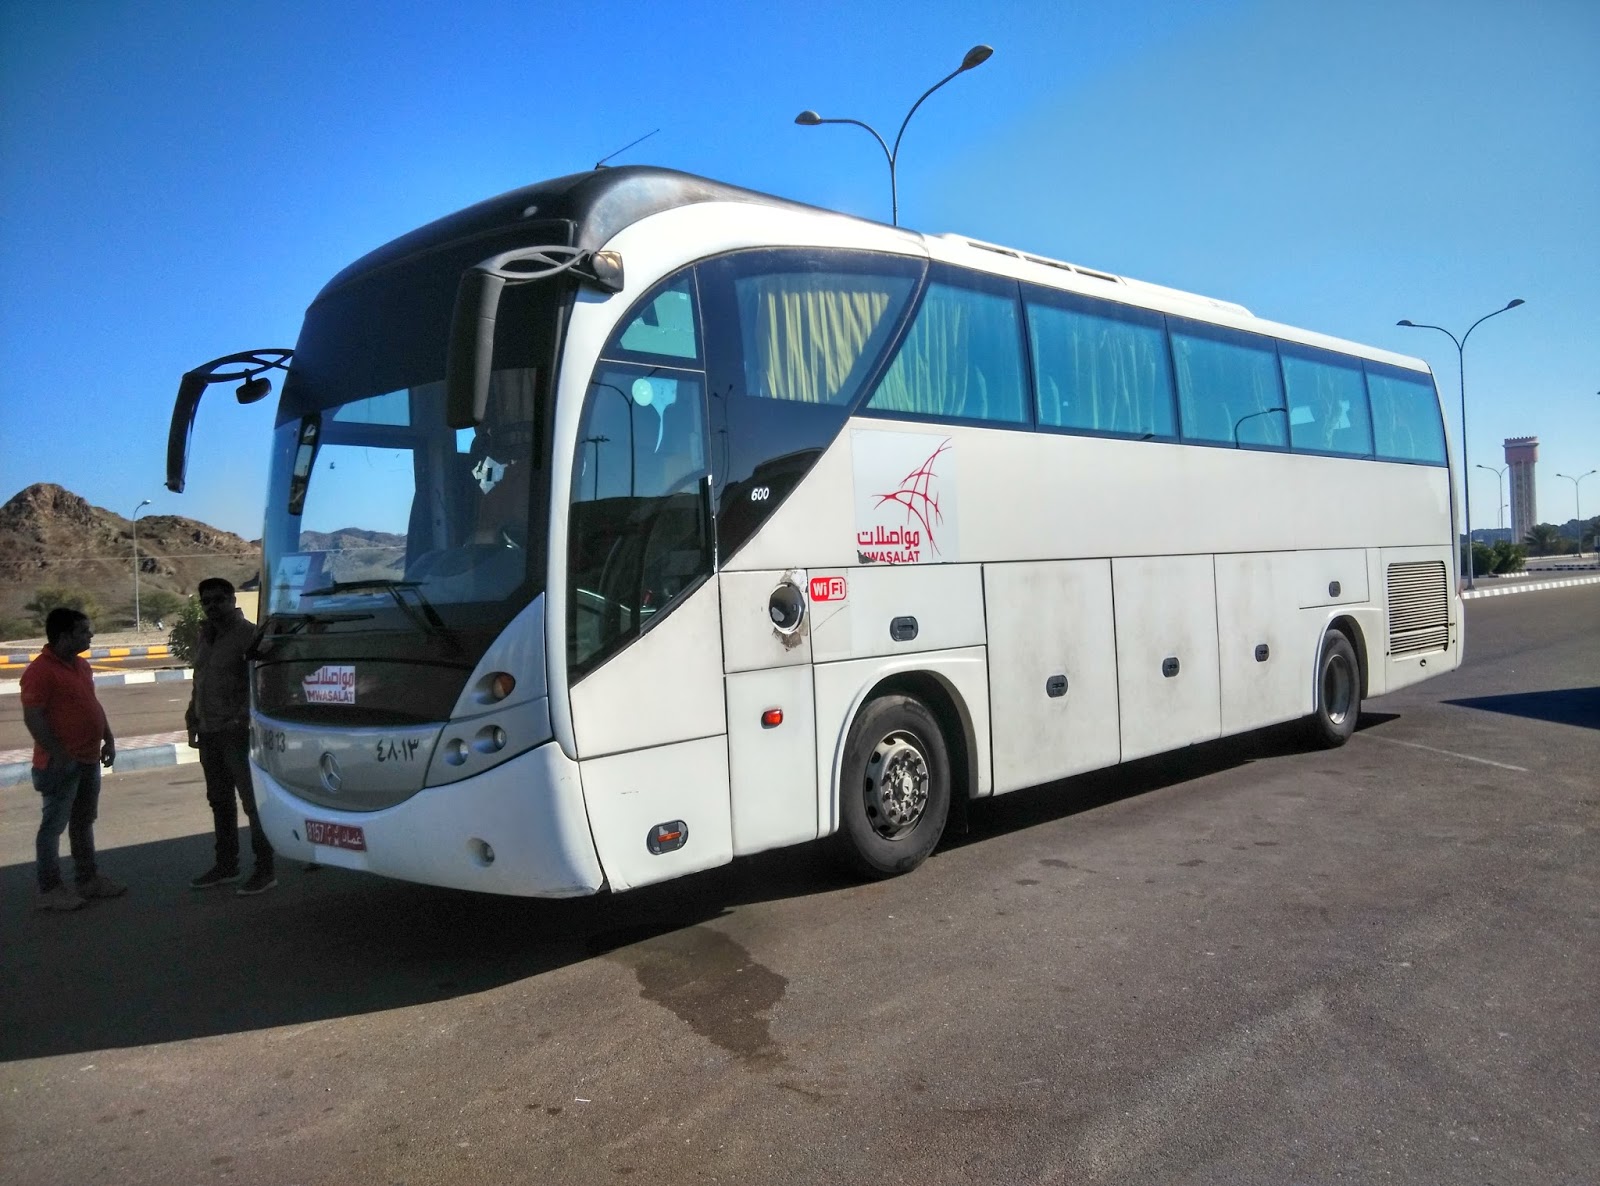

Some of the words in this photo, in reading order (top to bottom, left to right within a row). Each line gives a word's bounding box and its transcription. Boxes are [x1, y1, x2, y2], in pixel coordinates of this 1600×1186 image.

[751, 487, 770, 501] 600
[857, 525, 920, 550] مواصلات
[862, 550, 920, 563] WASALAT
[306, 690, 354, 703] MWASALAT
